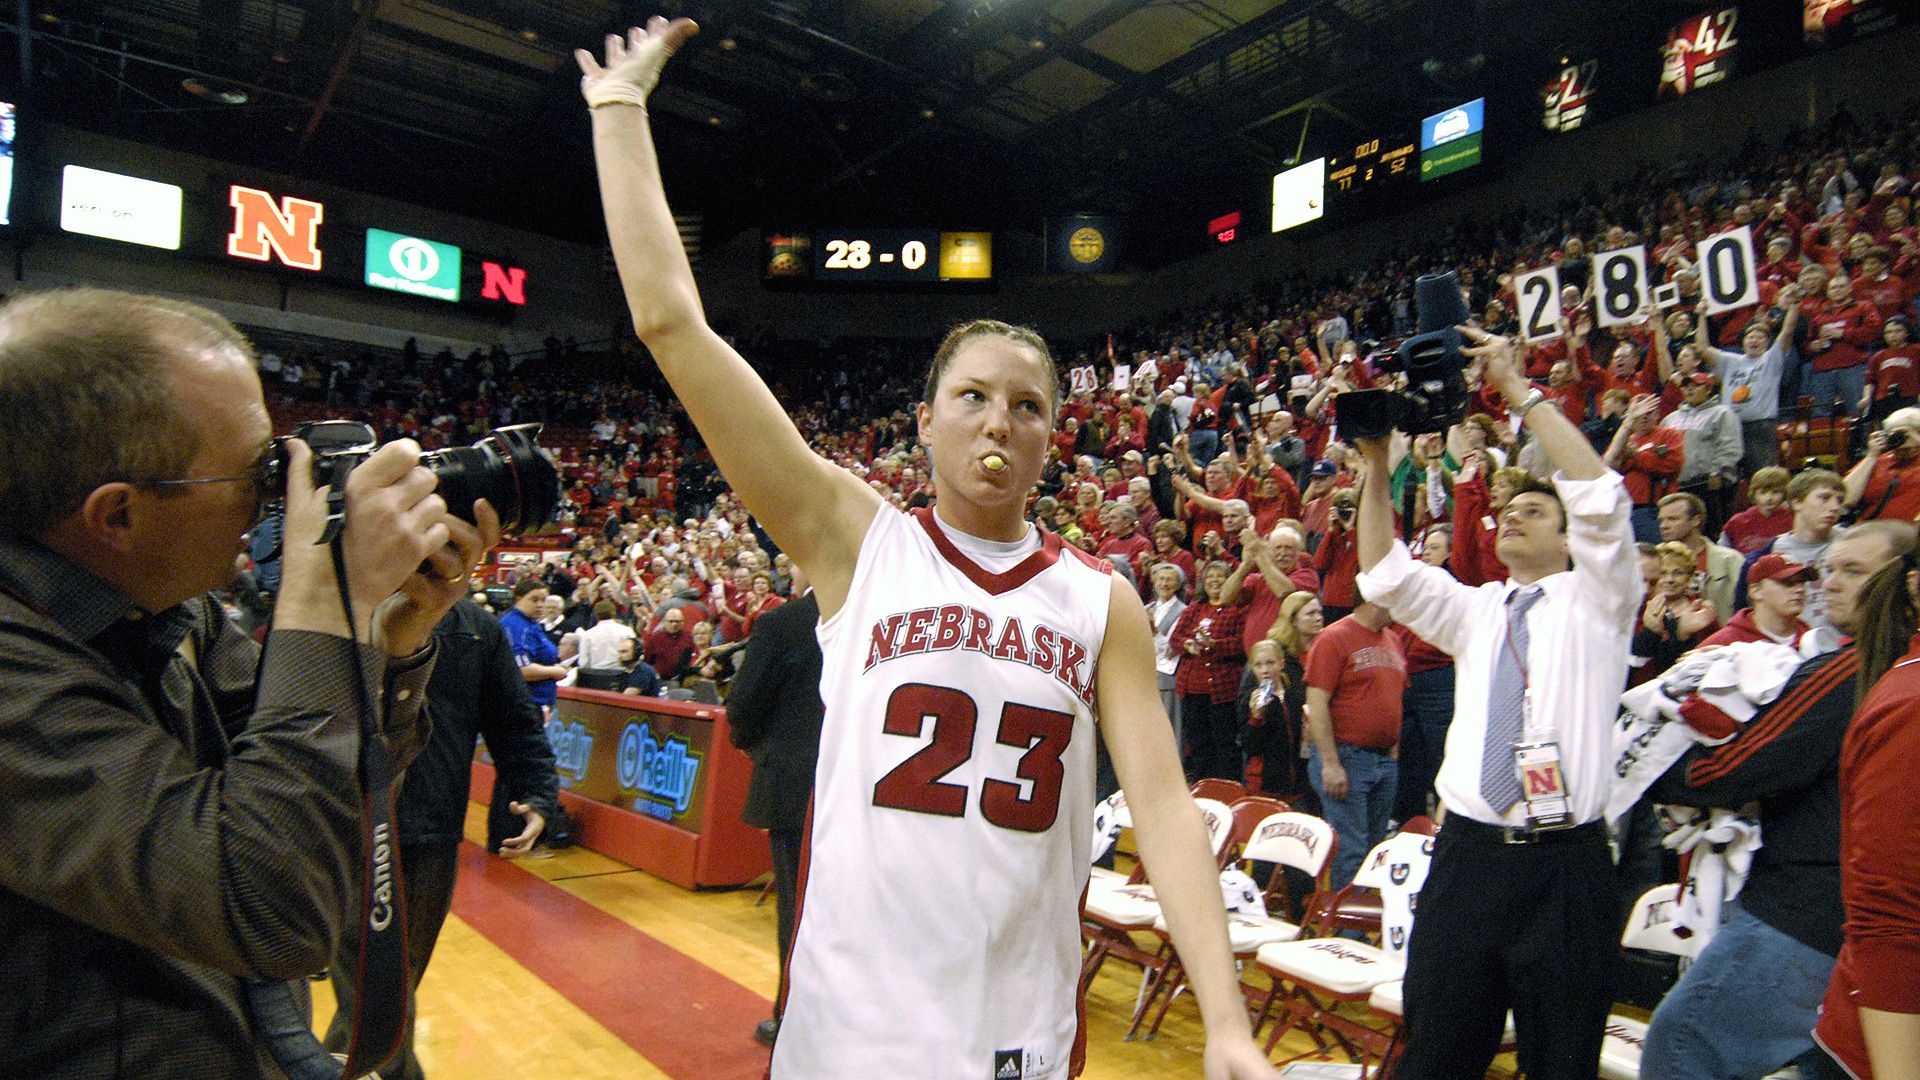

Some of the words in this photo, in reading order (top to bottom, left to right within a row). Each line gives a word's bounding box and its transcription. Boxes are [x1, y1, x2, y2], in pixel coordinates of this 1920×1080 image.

[1693, 7, 1739, 55] 42
[1365, 168, 1374, 181] 2
[1391, 157, 1407, 174] 52
[228, 185, 322, 271] N
[825, 240, 871, 269] 28
[902, 240, 926, 269] 0
[481, 262, 526, 304] N
[1523, 276, 1555, 338] 2
[1602, 255, 1639, 318] 8
[1707, 238, 1747, 304] 0
[617, 722, 699, 812] O'Reilly
[872, 682, 1075, 833] 23
[1527, 767, 1558, 795] N
[370, 822, 394, 933] Canon
